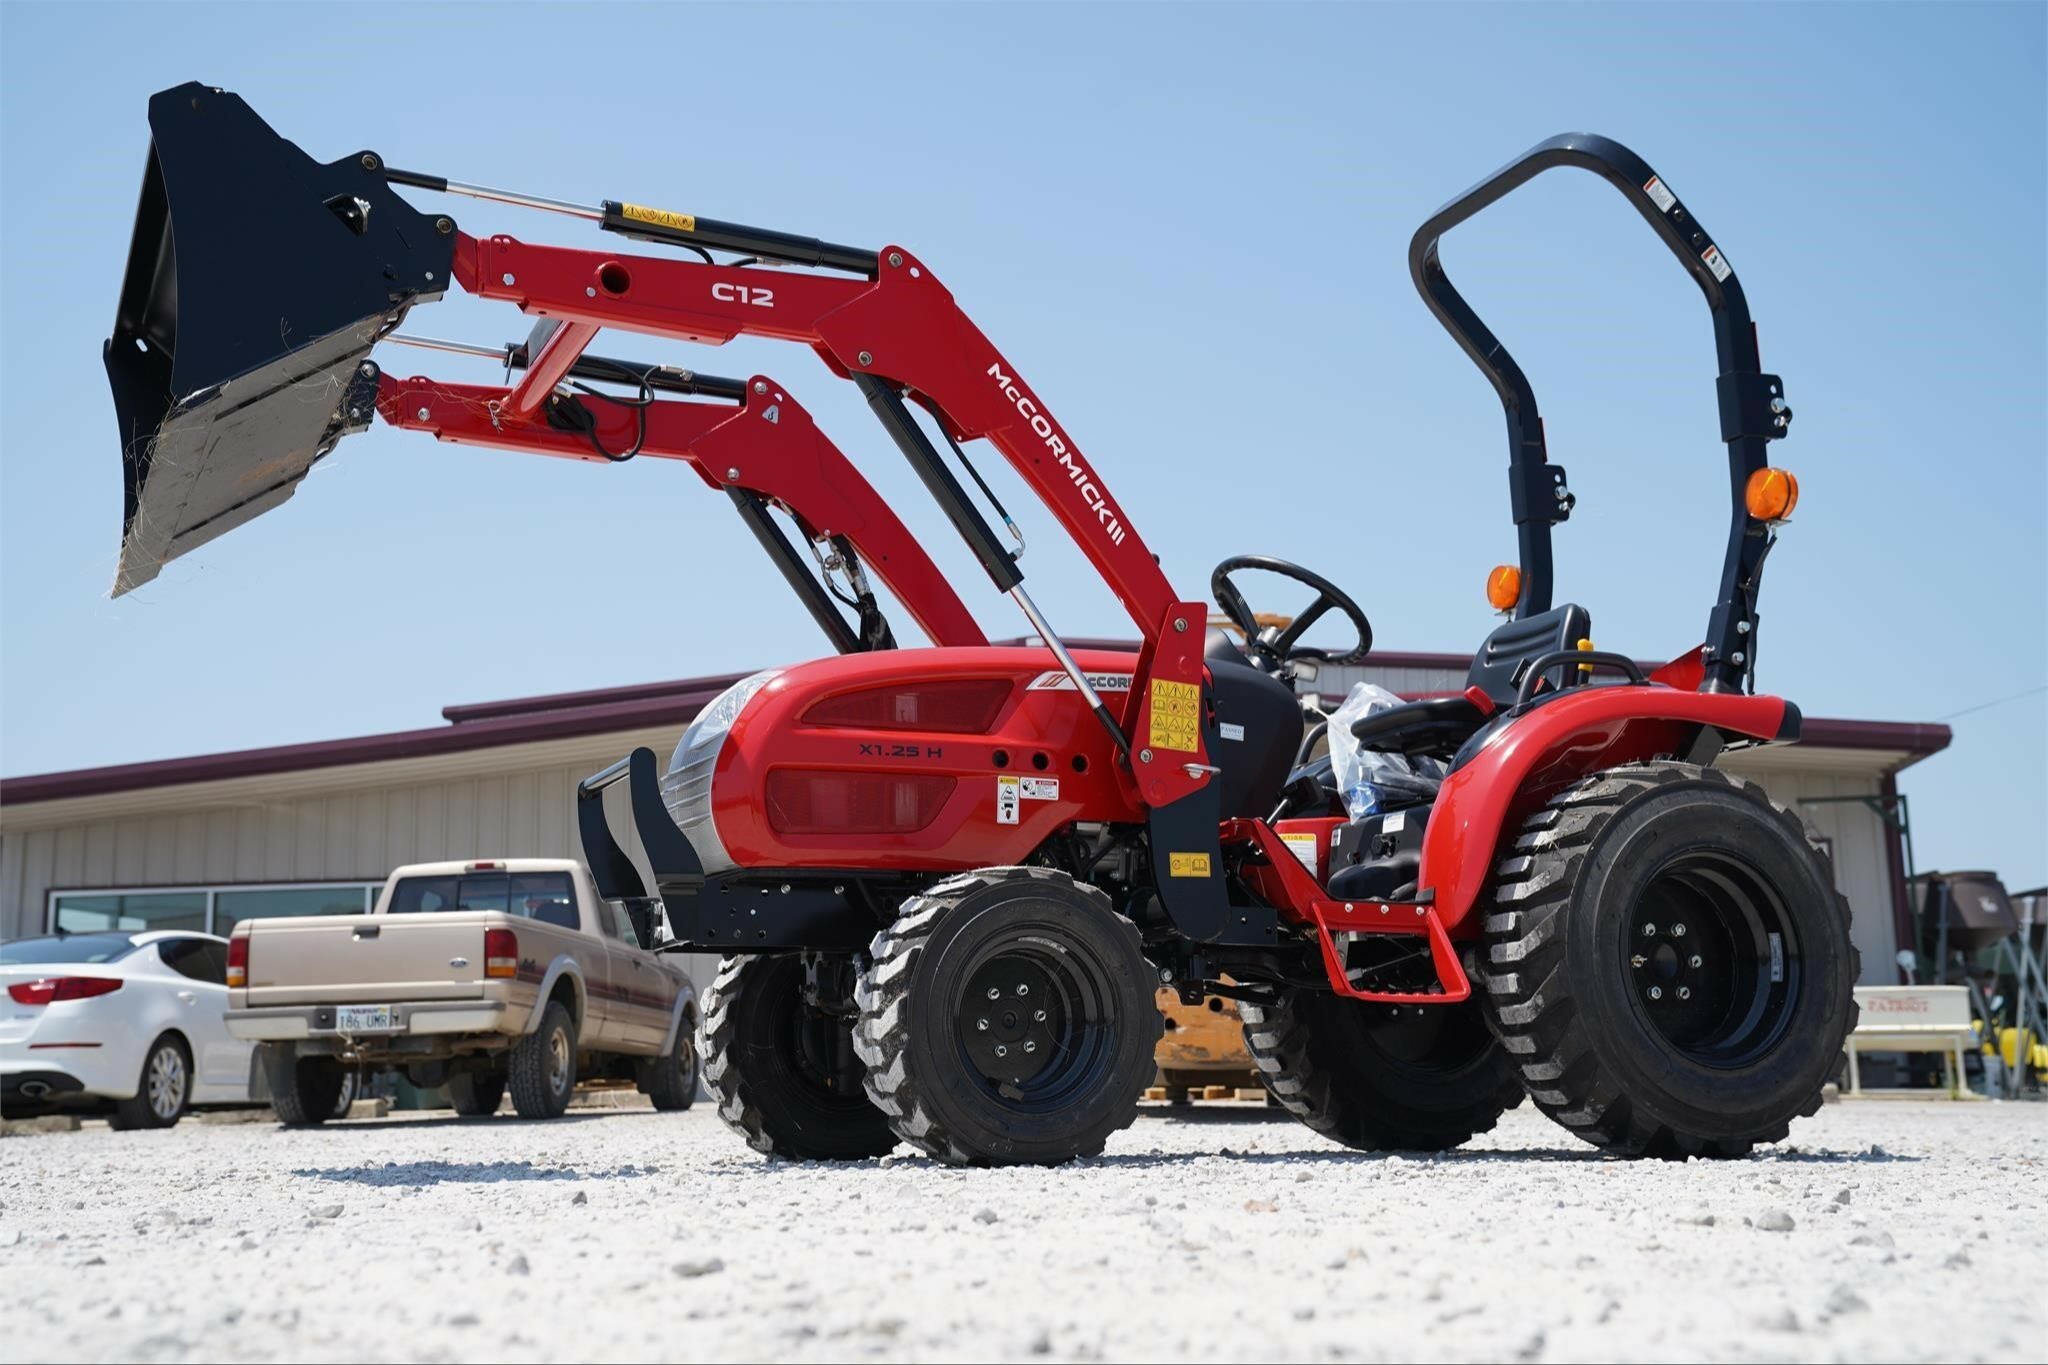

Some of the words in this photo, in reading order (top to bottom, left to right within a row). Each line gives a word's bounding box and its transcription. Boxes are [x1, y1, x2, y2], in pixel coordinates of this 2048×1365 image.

[712, 282, 774, 307] C12
[860, 743, 919, 757] X1.25
[927, 747, 942, 758] H
